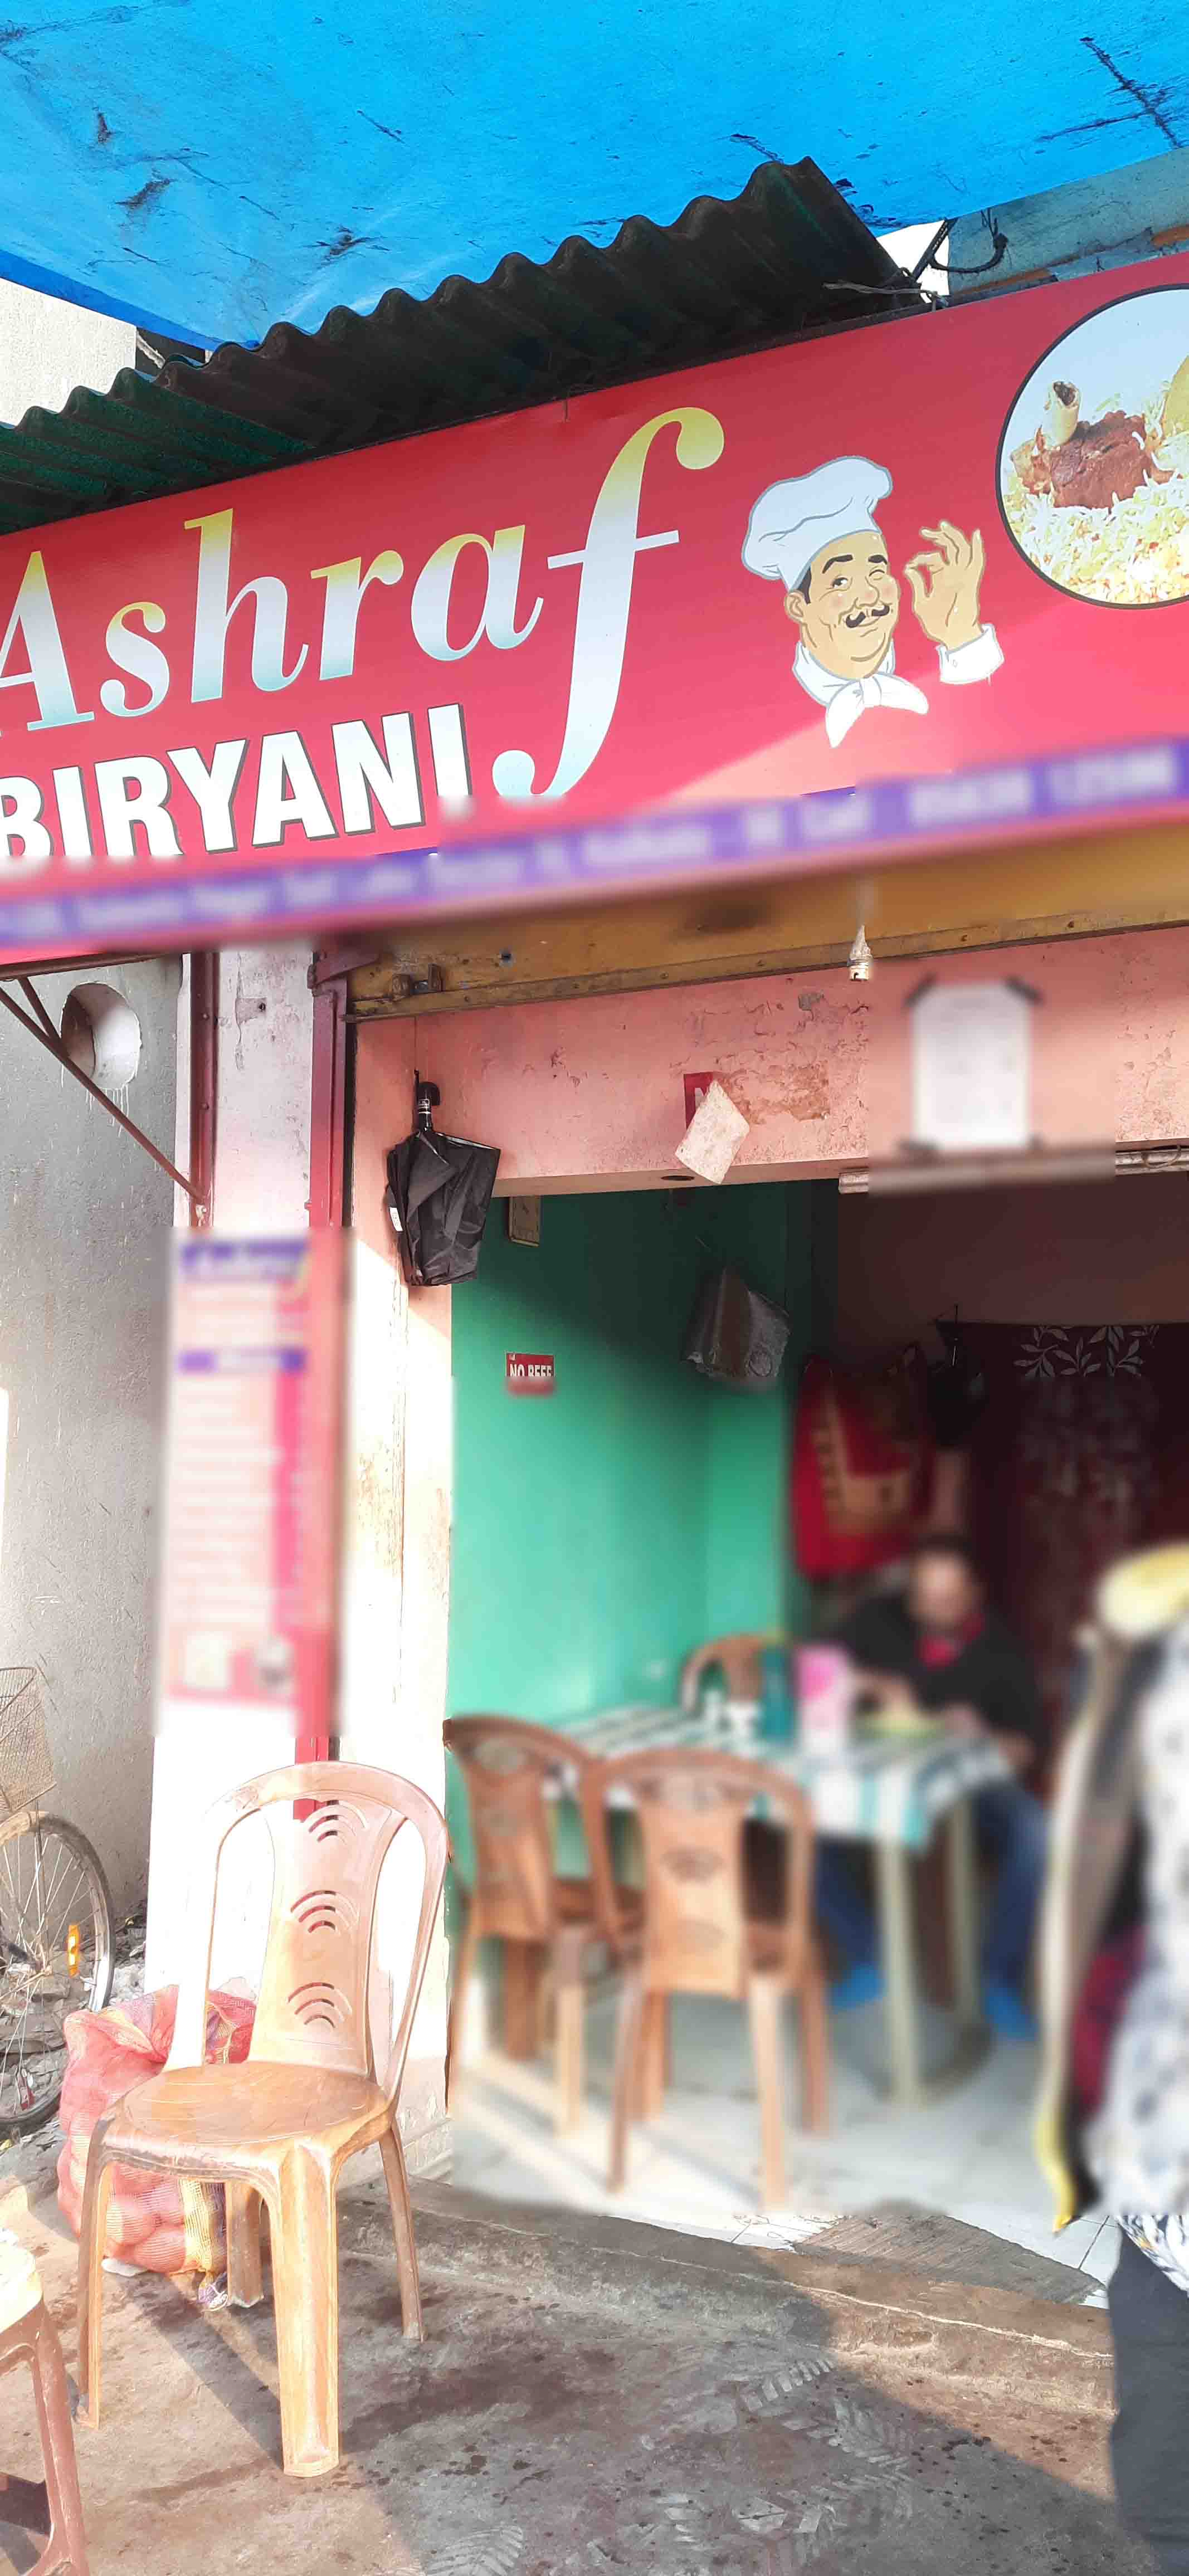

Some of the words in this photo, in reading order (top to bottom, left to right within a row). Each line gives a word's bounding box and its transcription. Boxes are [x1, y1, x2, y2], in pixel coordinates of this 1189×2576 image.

[0, 407, 725, 802] Ashraf
[0, 704, 473, 874] BIRYANI
[509, 1363, 525, 1379] NO
